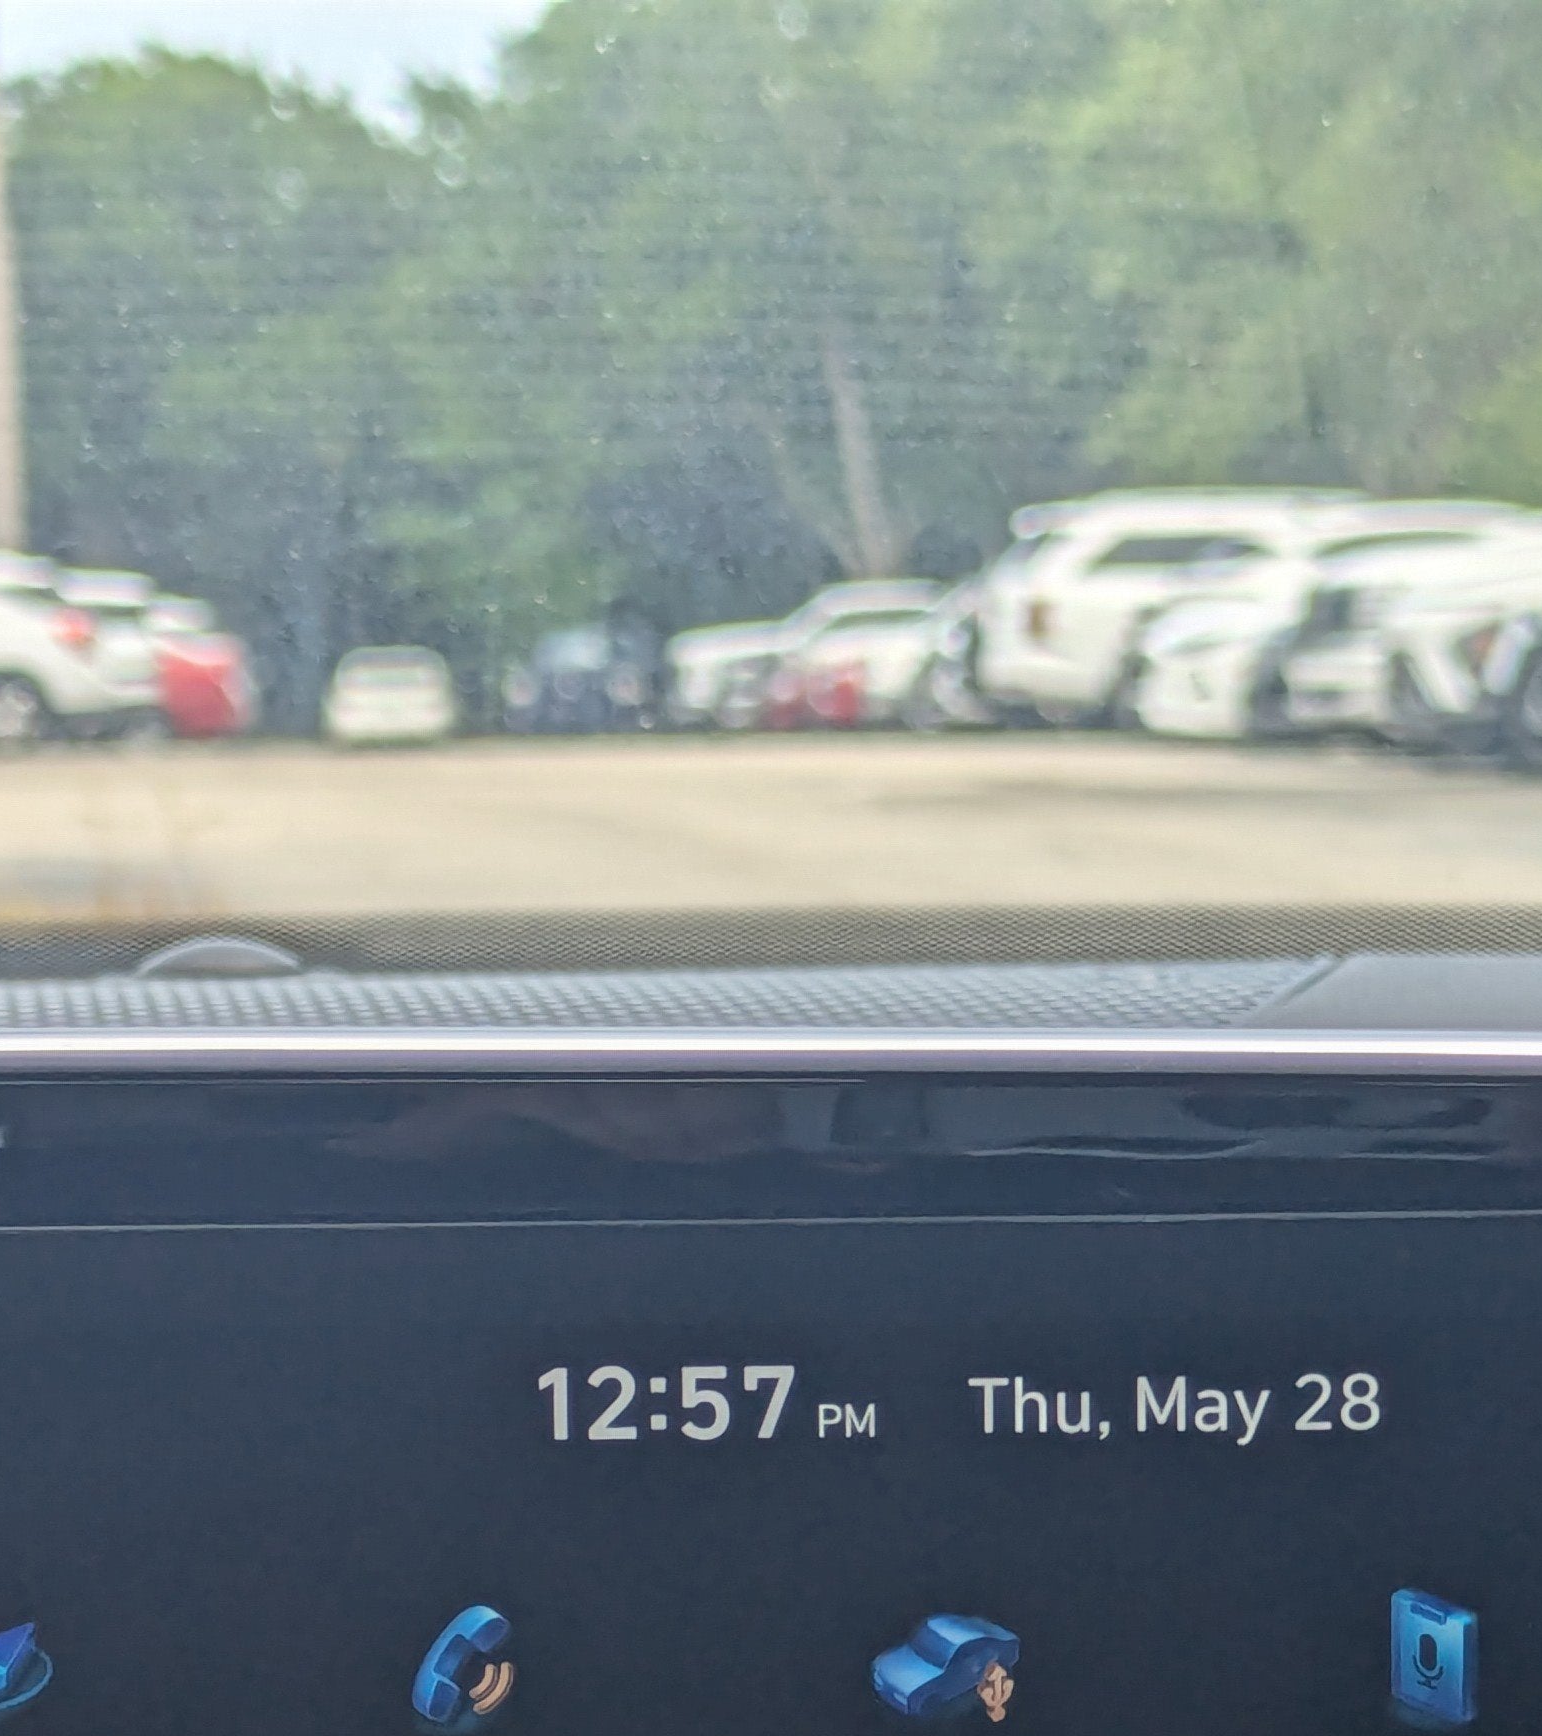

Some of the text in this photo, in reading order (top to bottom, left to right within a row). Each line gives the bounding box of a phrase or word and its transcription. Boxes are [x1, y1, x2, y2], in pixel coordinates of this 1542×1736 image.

[538, 1365, 876, 1441] 12:57 PM
[967, 1372, 1380, 1446] Thu, May 28
